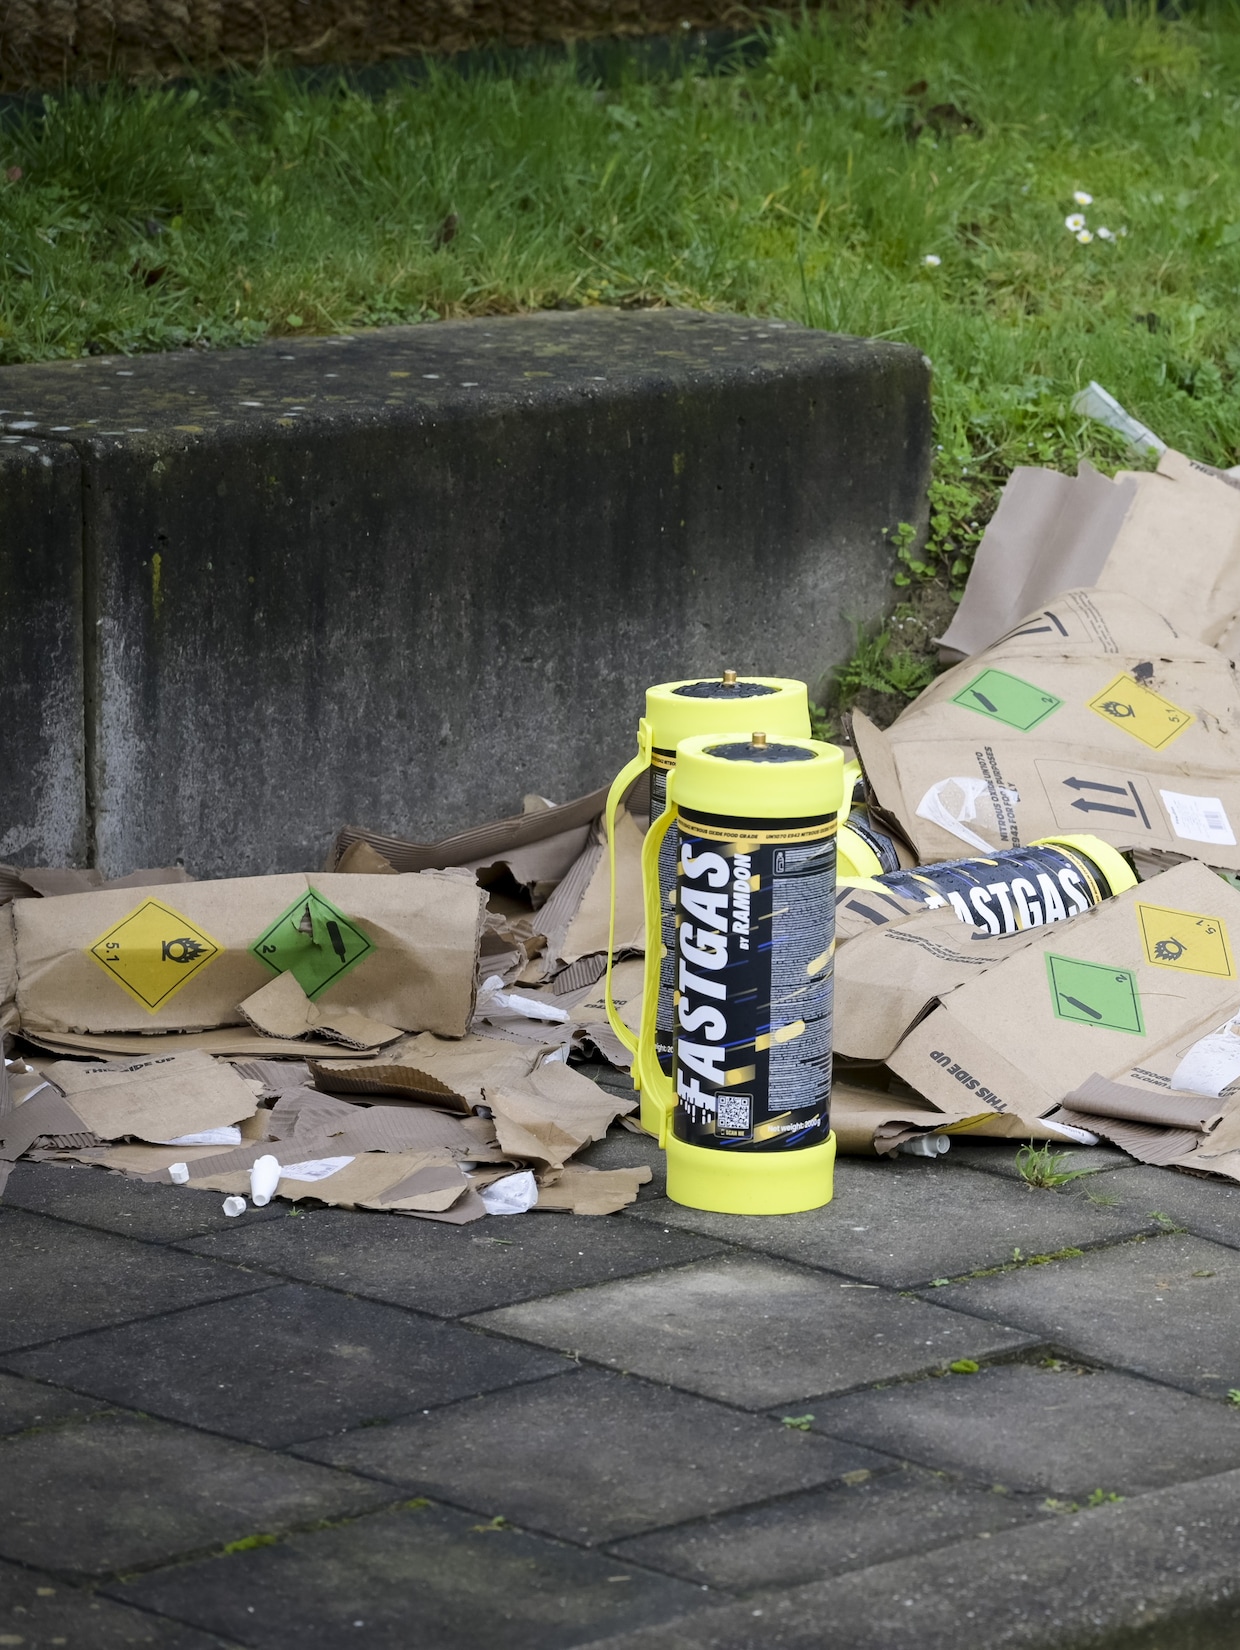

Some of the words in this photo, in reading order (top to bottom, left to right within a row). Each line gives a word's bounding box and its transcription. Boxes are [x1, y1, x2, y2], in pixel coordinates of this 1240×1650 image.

[1165, 709, 1180, 723] 5.1
[975, 752, 992, 780] UN1070
[984, 746, 1004, 786] PURPOSES
[987, 780, 999, 802] OXIDE
[993, 801, 1009, 842] NITROUS
[1006, 807, 1017, 825] FOR
[1009, 825, 1021, 849] E942
[732, 853, 751, 935] RAMDON
[1196, 919, 1216, 935] 5.1
[105, 941, 120, 962] 5.1
[262, 944, 277, 954] 2
[739, 936, 750, 950] BY
[677, 843, 731, 1113] FASTGAS
[1115, 974, 1128, 983] 2
[929, 1050, 951, 1067] UP
[947, 1063, 980, 1090] SIDE
[975, 1087, 1008, 1112] THIS
[781, 1122, 804, 1133] weight:
